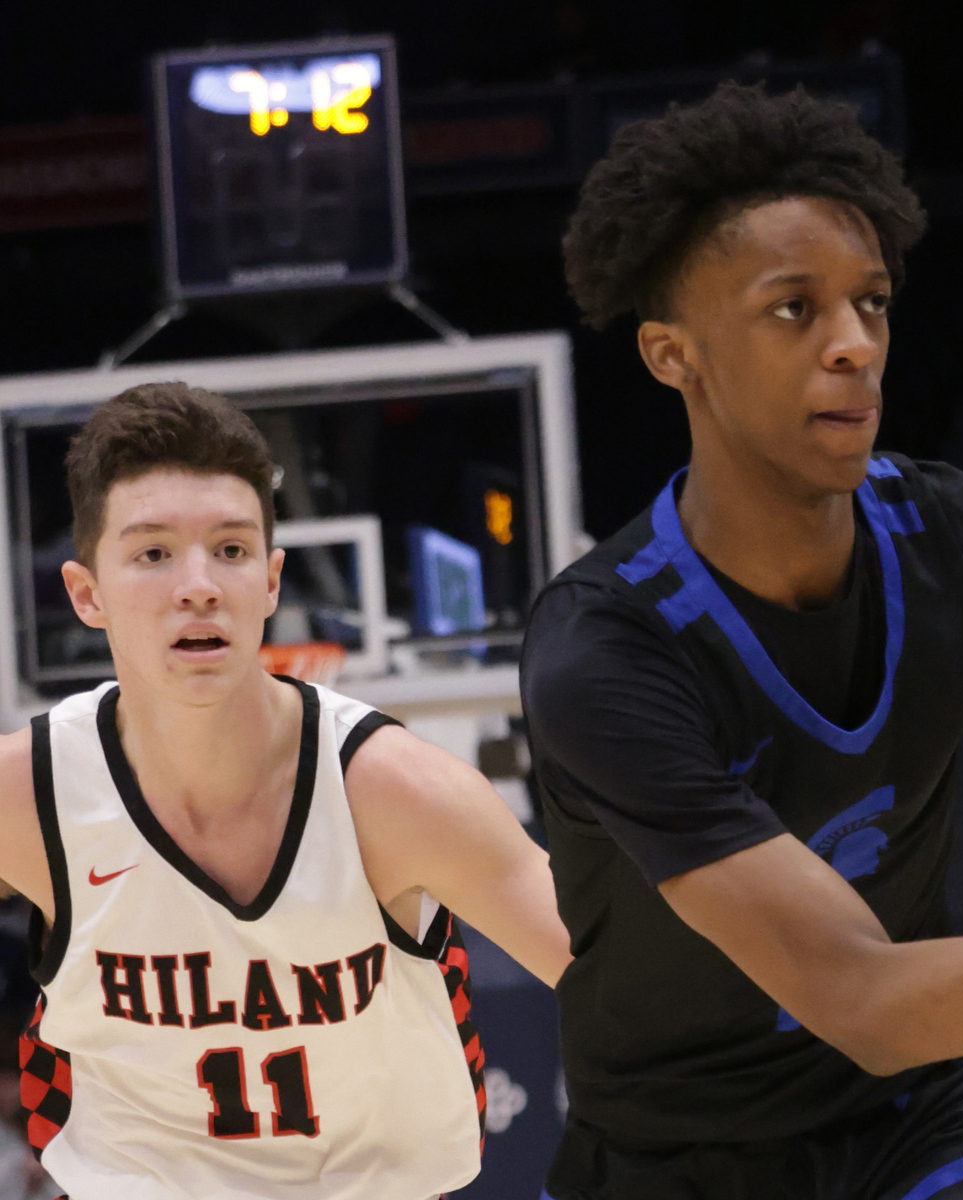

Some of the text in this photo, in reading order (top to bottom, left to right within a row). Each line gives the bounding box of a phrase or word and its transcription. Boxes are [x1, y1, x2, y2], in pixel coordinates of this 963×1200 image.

[229, 62, 372, 136] 7:12
[95, 942, 387, 1032] HILAND
[196, 1045, 321, 1140] 11
